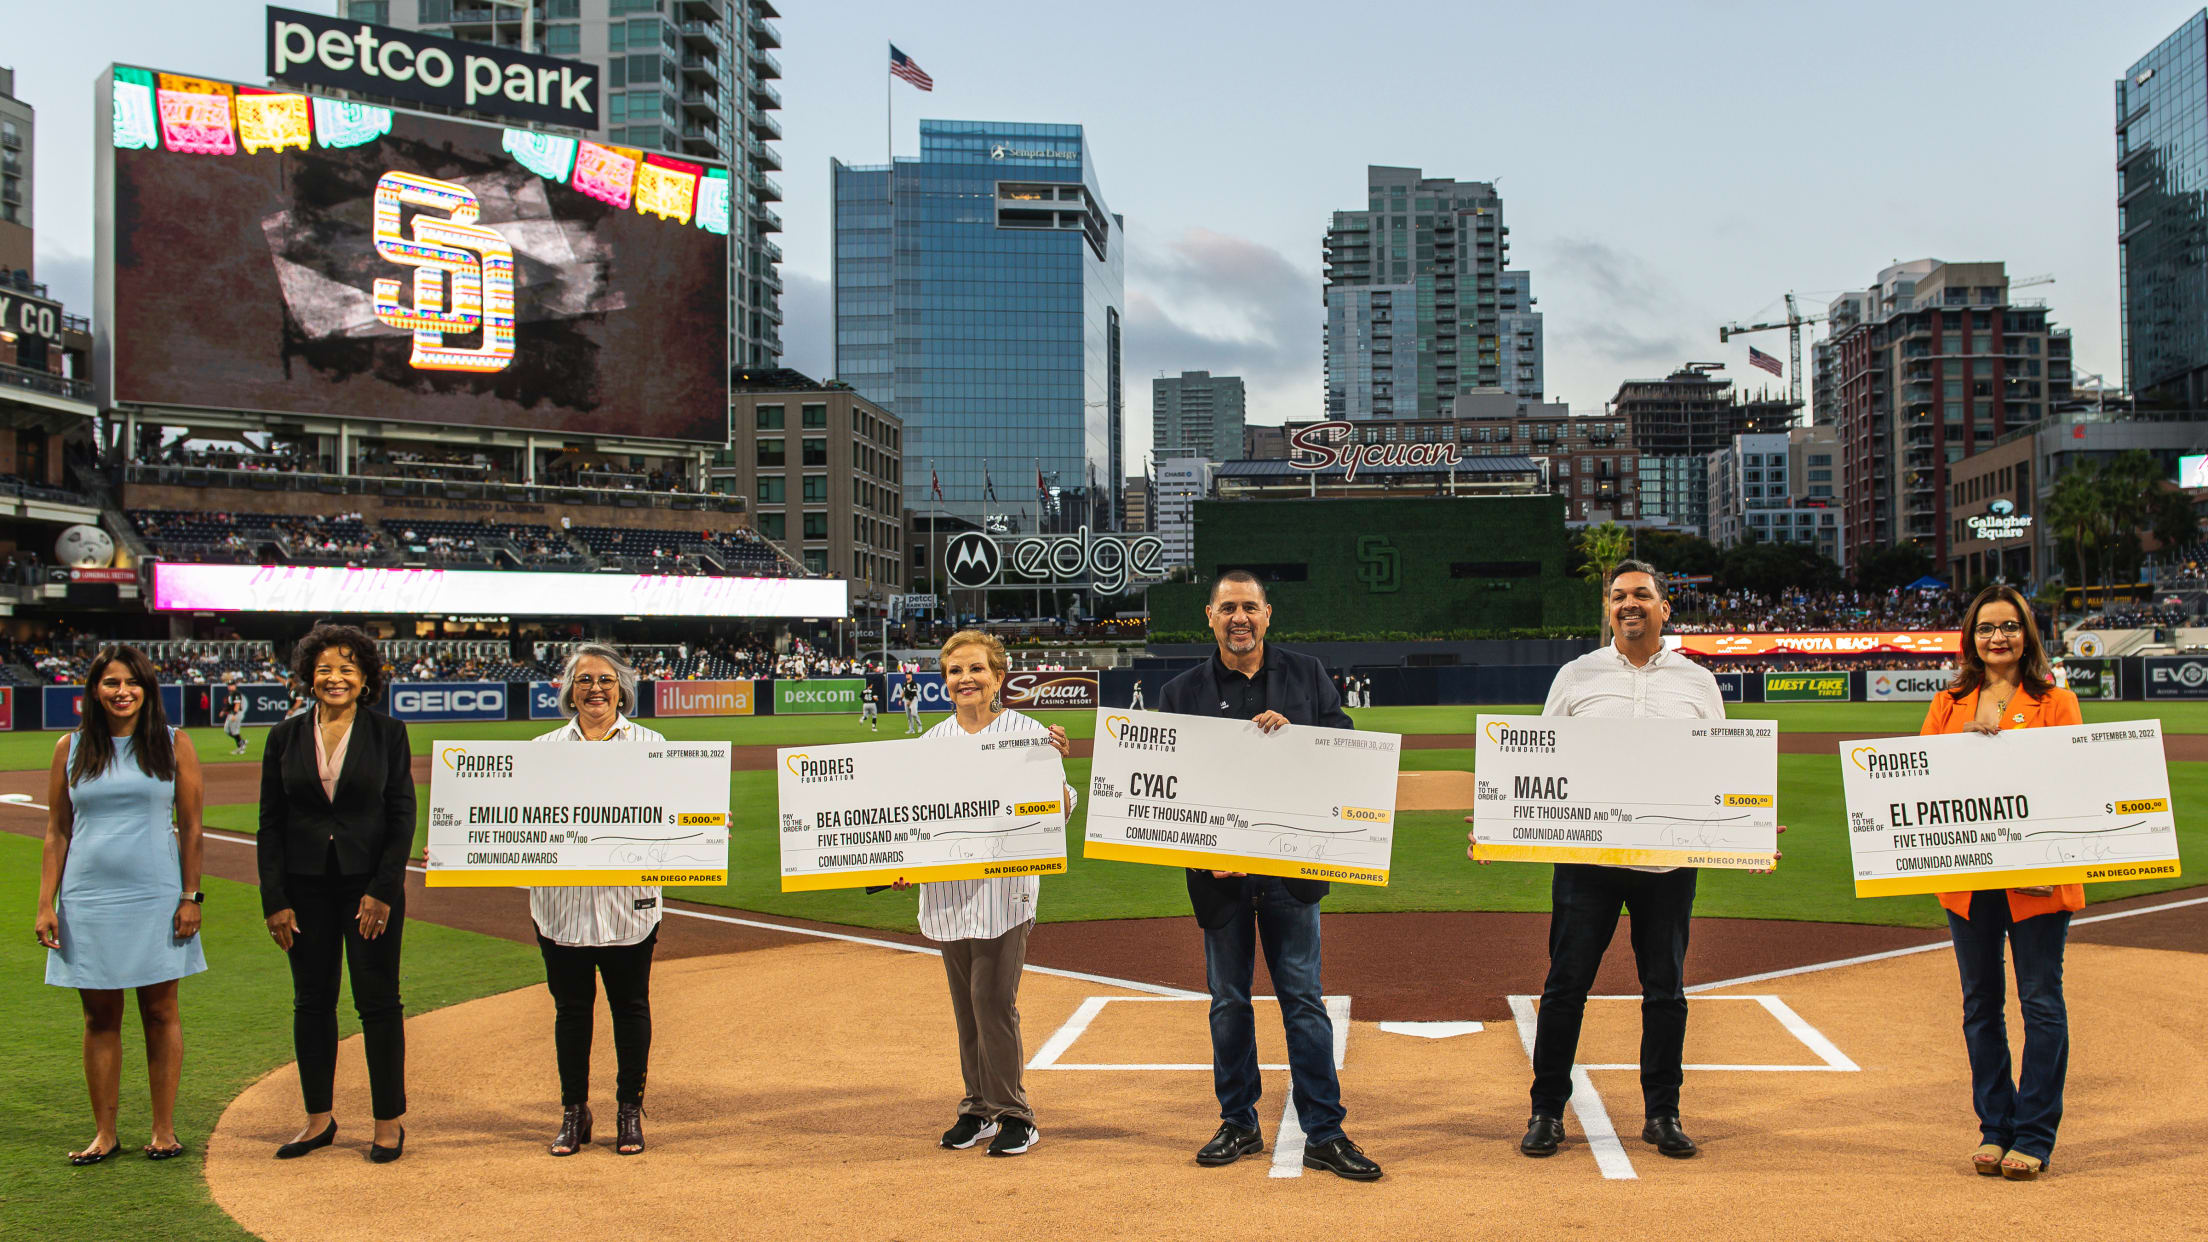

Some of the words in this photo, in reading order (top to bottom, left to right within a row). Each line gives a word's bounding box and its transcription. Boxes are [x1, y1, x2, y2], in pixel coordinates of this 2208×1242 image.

[275, 20, 454, 87] petco
[464, 54, 594, 114] park
[21, 302, 60, 340] CO.
[1288, 421, 1462, 482] Sycuan
[1968, 515, 2033, 529] Gallagher
[1977, 528, 2024, 540] Square
[1013, 525, 1165, 595] edge
[1775, 638, 1832, 650] TOYOTA
[1836, 637, 1878, 650] BEACH
[662, 687, 747, 710] illumina
[1006, 674, 1089, 706] Sycuan
[394, 690, 503, 712] GEICO
[1120, 724, 1176, 745] PADRES
[1501, 729, 1556, 746] PADRES
[1710, 728, 1744, 736] SEPTEMBER
[1745, 729, 1755, 737] 30,
[2091, 730, 2128, 741] SEPTEMBER
[2128, 730, 2138, 739] 30,
[2139, 729, 2155, 738] 2022
[998, 739, 1030, 748] SEPTEMBER
[1031, 738, 1040, 746] 30,
[1119, 742, 1176, 752] FOUNDATION
[1315, 738, 1330, 746] DATE
[1333, 738, 1368, 748] SEPTEMBER
[1368, 740, 1378, 750] 30,
[1379, 742, 1394, 750] 2022
[666, 750, 699, 758] SEPTEMBER
[700, 750, 709, 758] 30,
[1868, 751, 1928, 771] PADRES
[457, 755, 513, 772] PADRES
[801, 758, 854, 776] PADRES
[801, 774, 854, 783] FOUNDATION
[1870, 769, 1930, 779] FOUNDATION
[1093, 790, 1113, 798] ORDER
[1130, 772, 1178, 799] CYAC
[1514, 776, 1568, 800] MAAC
[469, 806, 518, 824] EMILIO
[522, 806, 569, 824] NARES
[572, 806, 662, 824] FOUNDATION
[817, 811, 841, 828] BEA
[844, 806, 909, 826] GONZALES
[912, 800, 1000, 821] SCHOLARSHIP
[1128, 804, 1150, 819] FIVE
[1153, 806, 1207, 823] THOUSAND
[1209, 816, 1225, 825] AND
[1513, 806, 1535, 819] FIVE
[1537, 806, 1591, 820] THOUSAND
[1594, 812, 1609, 821] AND
[1890, 803, 1913, 827] EL
[1916, 794, 2029, 825] PATRONATO
[468, 831, 490, 843] FIVE
[492, 831, 547, 843] THOUSAND
[549, 835, 565, 843] AND
[818, 834, 838, 847] FIVE
[840, 830, 892, 845] THOUSAND
[894, 832, 908, 841] AND
[1126, 826, 1178, 843] COMUNIDAD
[1180, 831, 1217, 846] AWARDS
[1513, 827, 1564, 840] COMUNIDAD
[1566, 829, 1602, 841] AWARDS
[1894, 834, 1917, 848] FIVE
[1919, 830, 1978, 847] THOUSAND
[1980, 832, 1996, 842] AND
[467, 852, 520, 864] COMUNIDAD
[521, 853, 558, 864] AWARDS
[818, 853, 867, 867] COMUNIDAD
[870, 850, 904, 864] AWARDS
[1896, 855, 1952, 871] COMUNIDAD
[1954, 852, 1993, 867] AWARDS
[1003, 865, 1028, 873] DIEGO
[1030, 863, 1062, 871] PADRES
[1300, 868, 1318, 876] SAN
[1320, 870, 1347, 879] DIEGO
[1349, 872, 1383, 881] PADRES
[2108, 868, 2136, 877] DIEGO
[2139, 866, 2175, 875] PADRES
